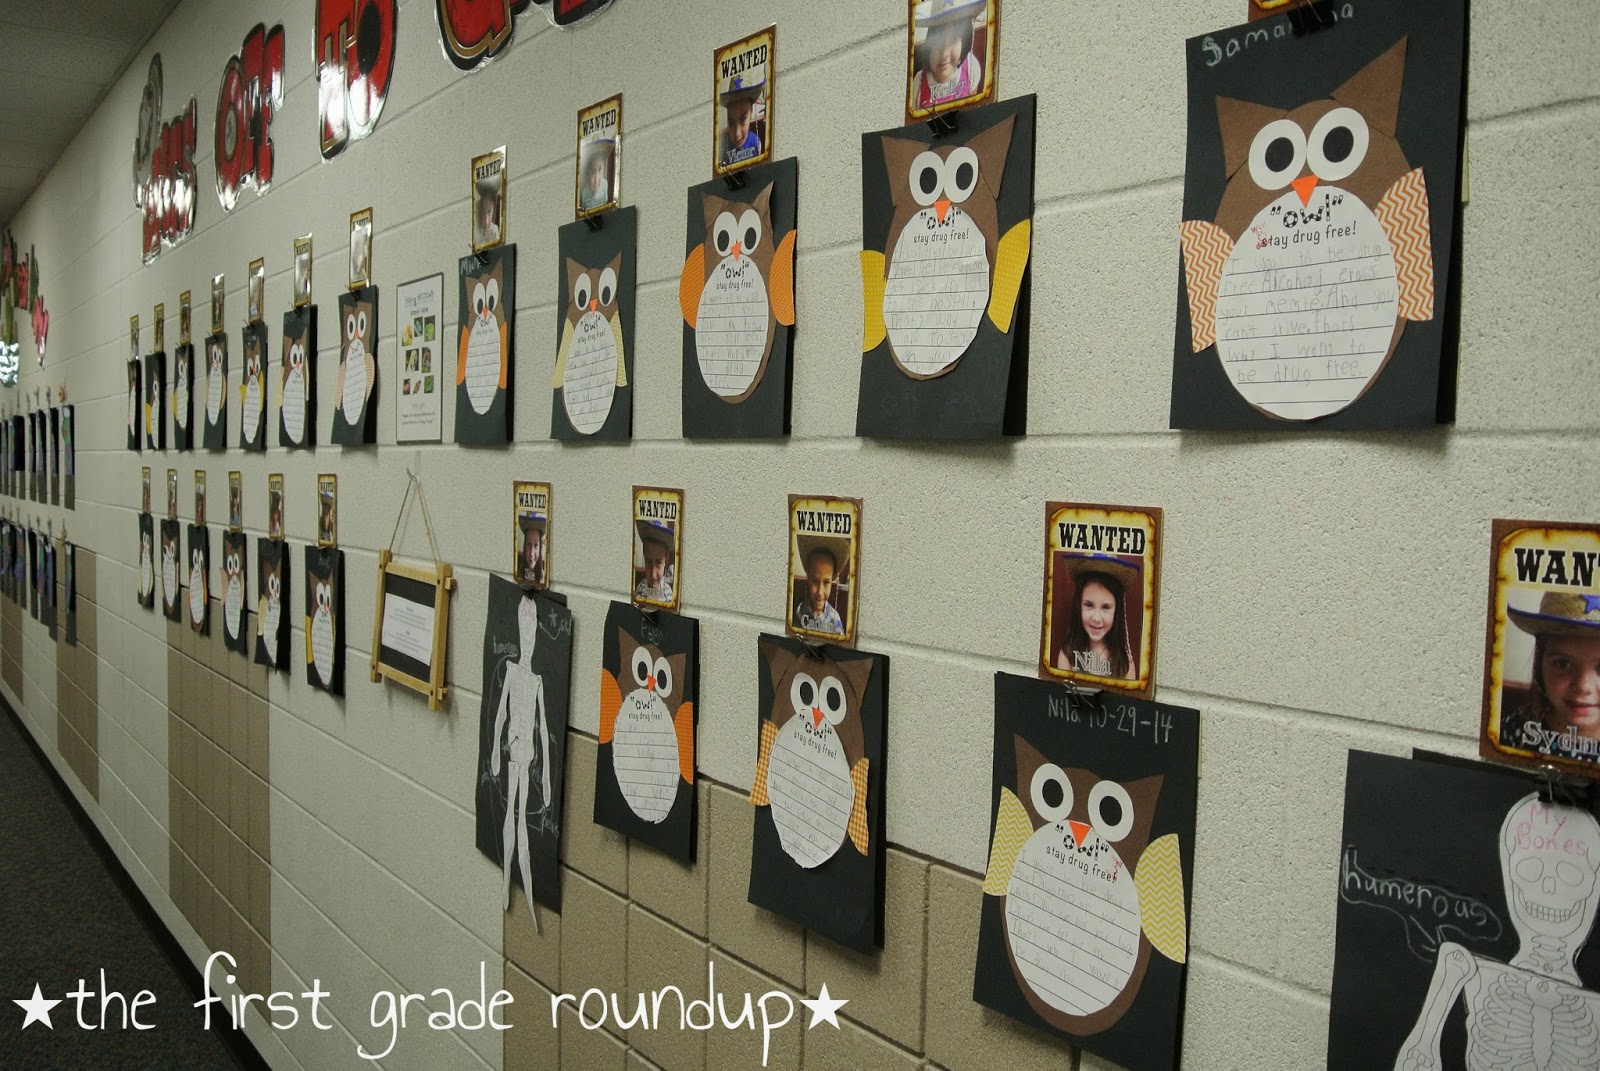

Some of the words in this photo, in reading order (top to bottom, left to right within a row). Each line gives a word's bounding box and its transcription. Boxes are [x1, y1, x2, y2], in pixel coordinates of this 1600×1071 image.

[721, 44, 767, 79] WANTED
[583, 109, 616, 136] WANTED
[727, 145, 756, 163] Victor
[476, 158, 502, 181] WANTED
[914, 231, 929, 246] stay
[931, 230, 948, 244] drug
[950, 227, 970, 240] free!
[1261, 233, 1288, 250] stay
[1292, 230, 1320, 244] drug
[1325, 220, 1356, 239] free!
[1329, 247, 1344, 262] be
[716, 282, 728, 292] stay
[728, 280, 740, 291] drug
[740, 279, 754, 289] free!
[1350, 337, 1365, 355] to
[1237, 369, 1257, 382] be
[1274, 363, 1311, 387] drug
[518, 492, 546, 509] WANTED
[639, 499, 677, 520] WANTED
[797, 510, 851, 535] WANTED
[1058, 522, 1146, 555] WANTED
[1514, 547, 1600, 588] WAN
[1072, 650, 1112, 676] Nila
[640, 712, 650, 722] drug
[1047, 694, 1081, 724] Nila
[1089, 703, 1173, 744] 10-29-14
[794, 731, 806, 746] stay
[807, 737, 821, 753] drug
[822, 743, 837, 760] free!
[1522, 720, 1600, 756] Sydn
[1530, 803, 1567, 839] My
[1515, 821, 1587, 857] Bones
[1046, 845, 1066, 864] stay
[1068, 856, 1089, 875] drug
[1092, 864, 1117, 884] free!
[1343, 847, 1487, 926] humerous
